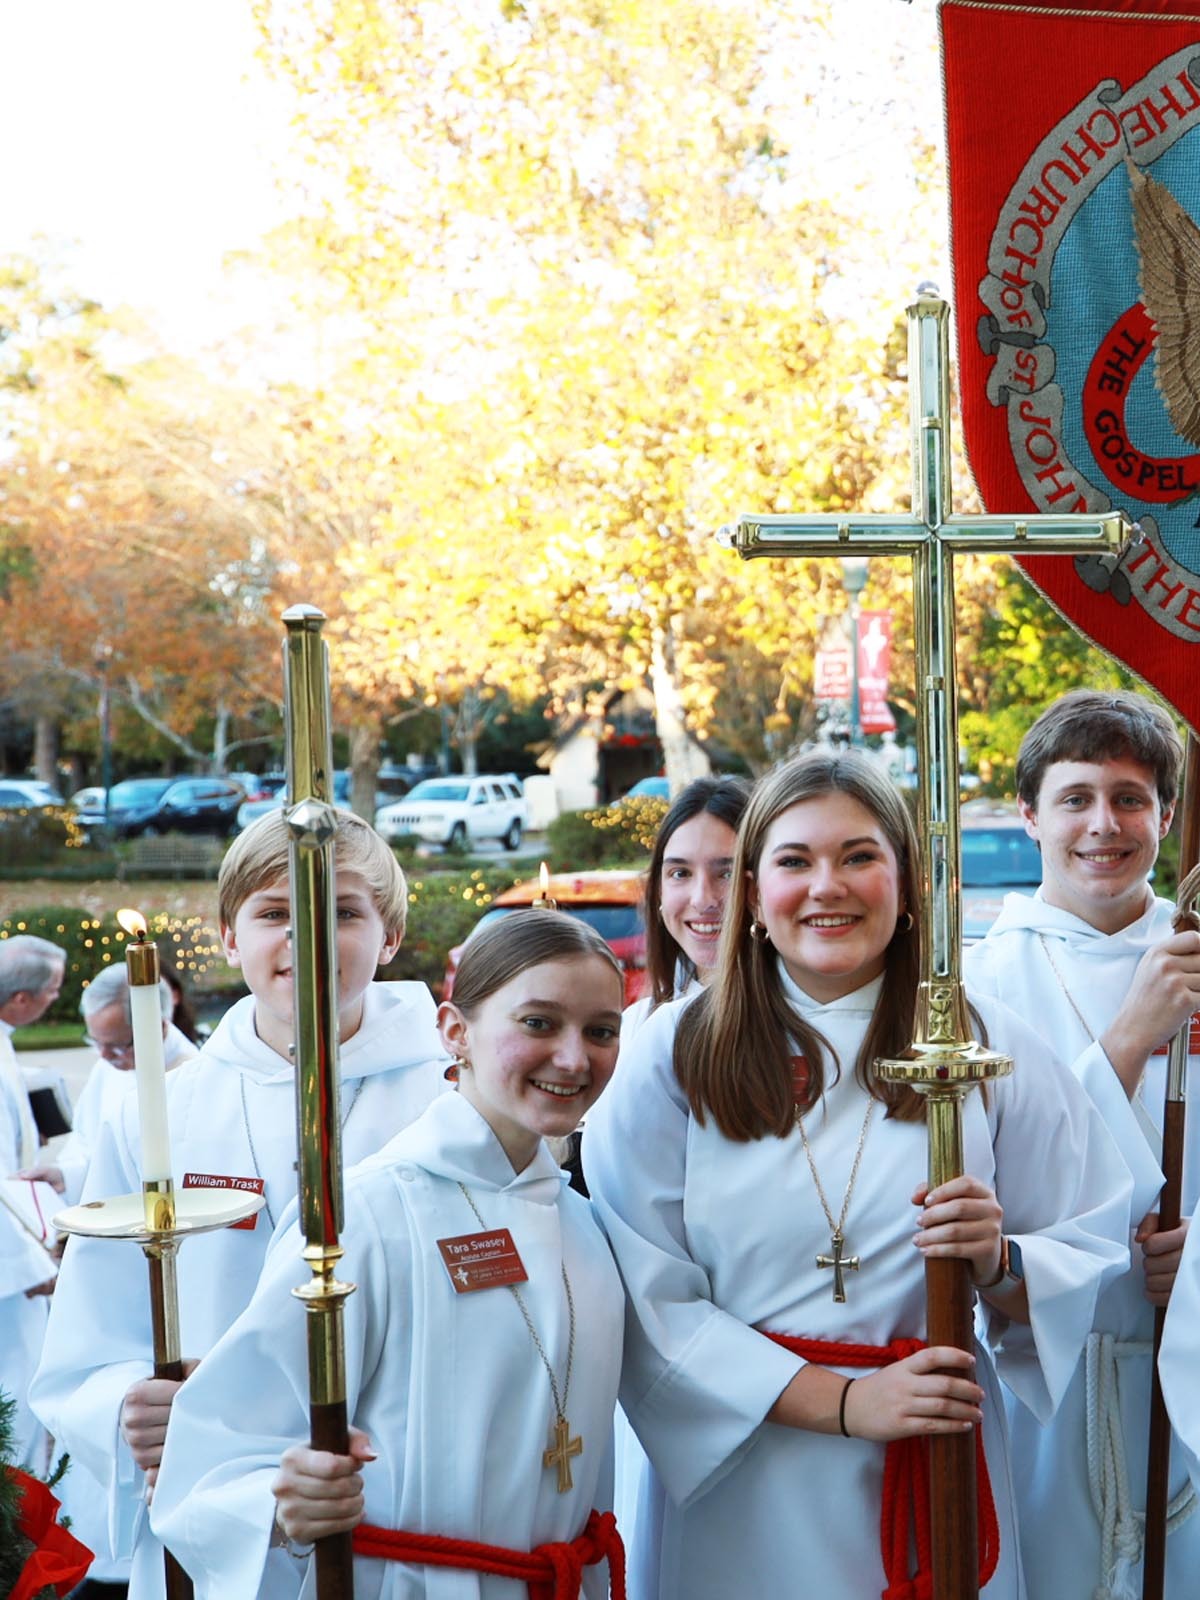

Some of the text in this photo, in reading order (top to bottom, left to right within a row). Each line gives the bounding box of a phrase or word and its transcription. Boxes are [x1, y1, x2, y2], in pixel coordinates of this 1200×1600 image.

[1002, 108, 1122, 287] CHURCH
[1000, 285, 1033, 331] OF
[1099, 329, 1147, 396] THE
[1094, 408, 1199, 492] GOSPEL
[188, 1174, 260, 1190] William Trask
[446, 1238, 505, 1254] Tara Swasey
